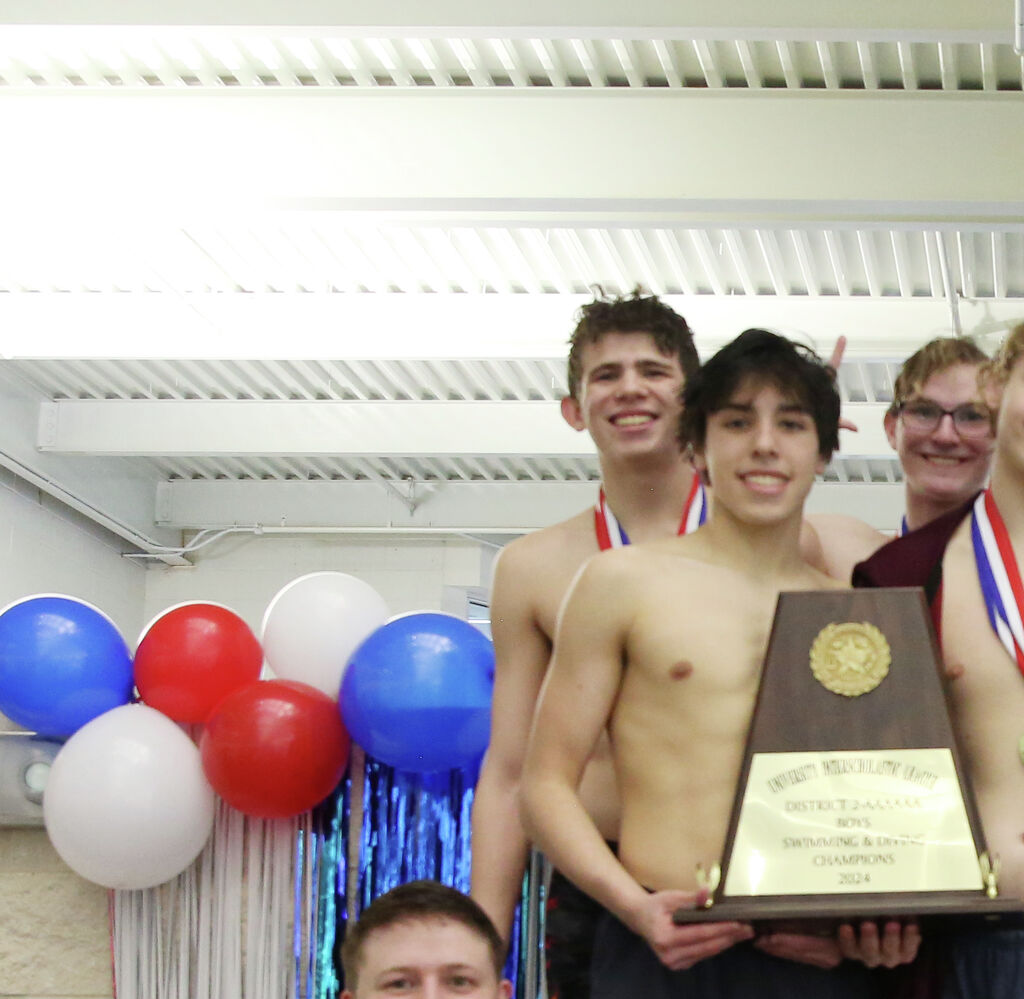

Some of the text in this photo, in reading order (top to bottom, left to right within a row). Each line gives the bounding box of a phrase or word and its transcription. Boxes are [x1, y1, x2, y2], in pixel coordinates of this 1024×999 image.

[785, 799, 846, 812] DISTRICT
[836, 817, 872, 828] BOYS
[783, 836, 859, 849] SWIMMING
[863, 836, 873, 847] &
[812, 853, 896, 867] CHAMPIONS
[838, 872, 872, 885] 2024
